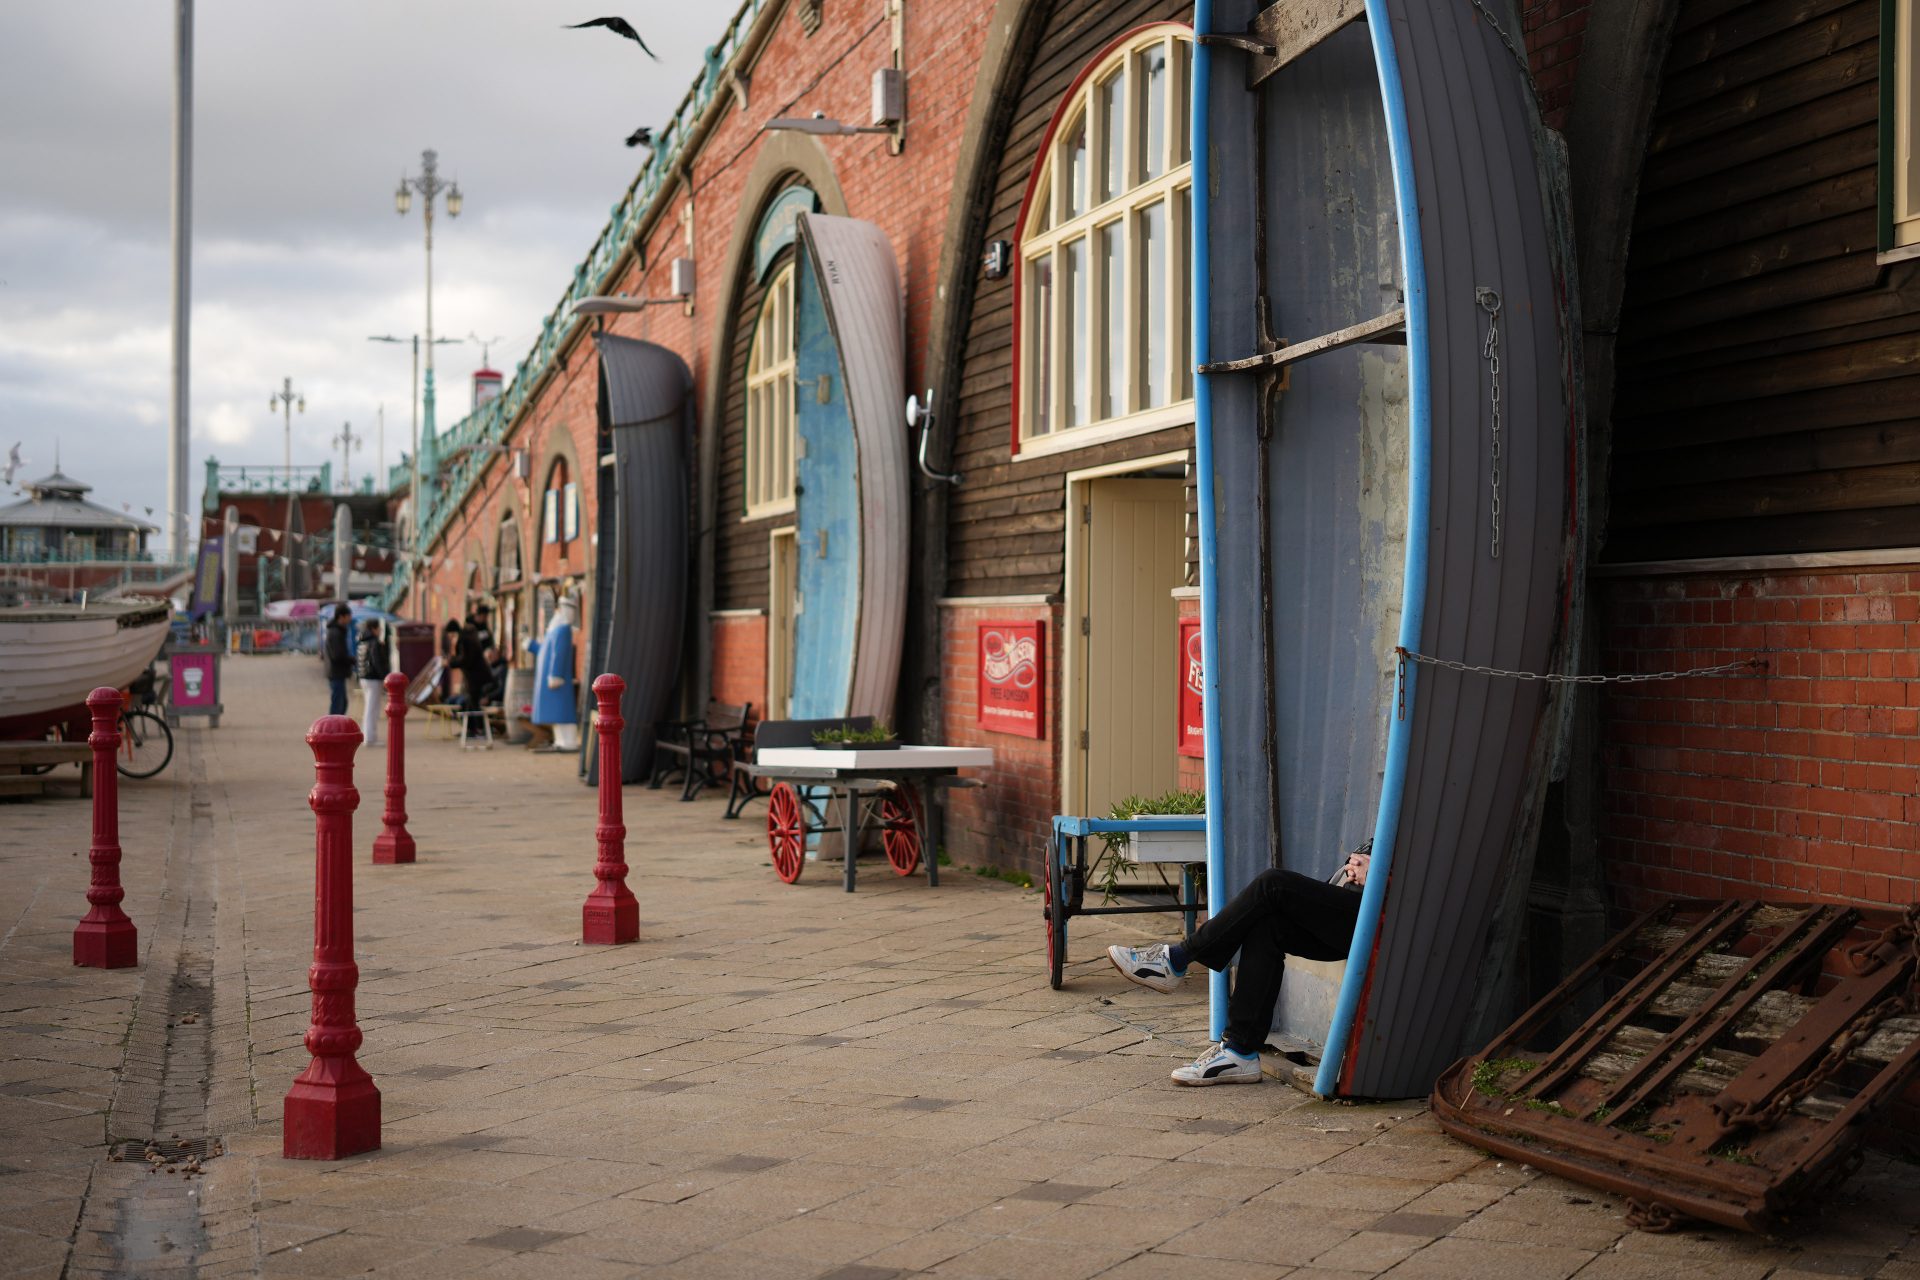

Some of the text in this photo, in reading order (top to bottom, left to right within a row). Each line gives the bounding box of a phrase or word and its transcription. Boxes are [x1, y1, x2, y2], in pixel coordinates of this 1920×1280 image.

[827, 260, 840, 284] RYAN
[990, 687, 1030, 702] FREE ADMISSION
